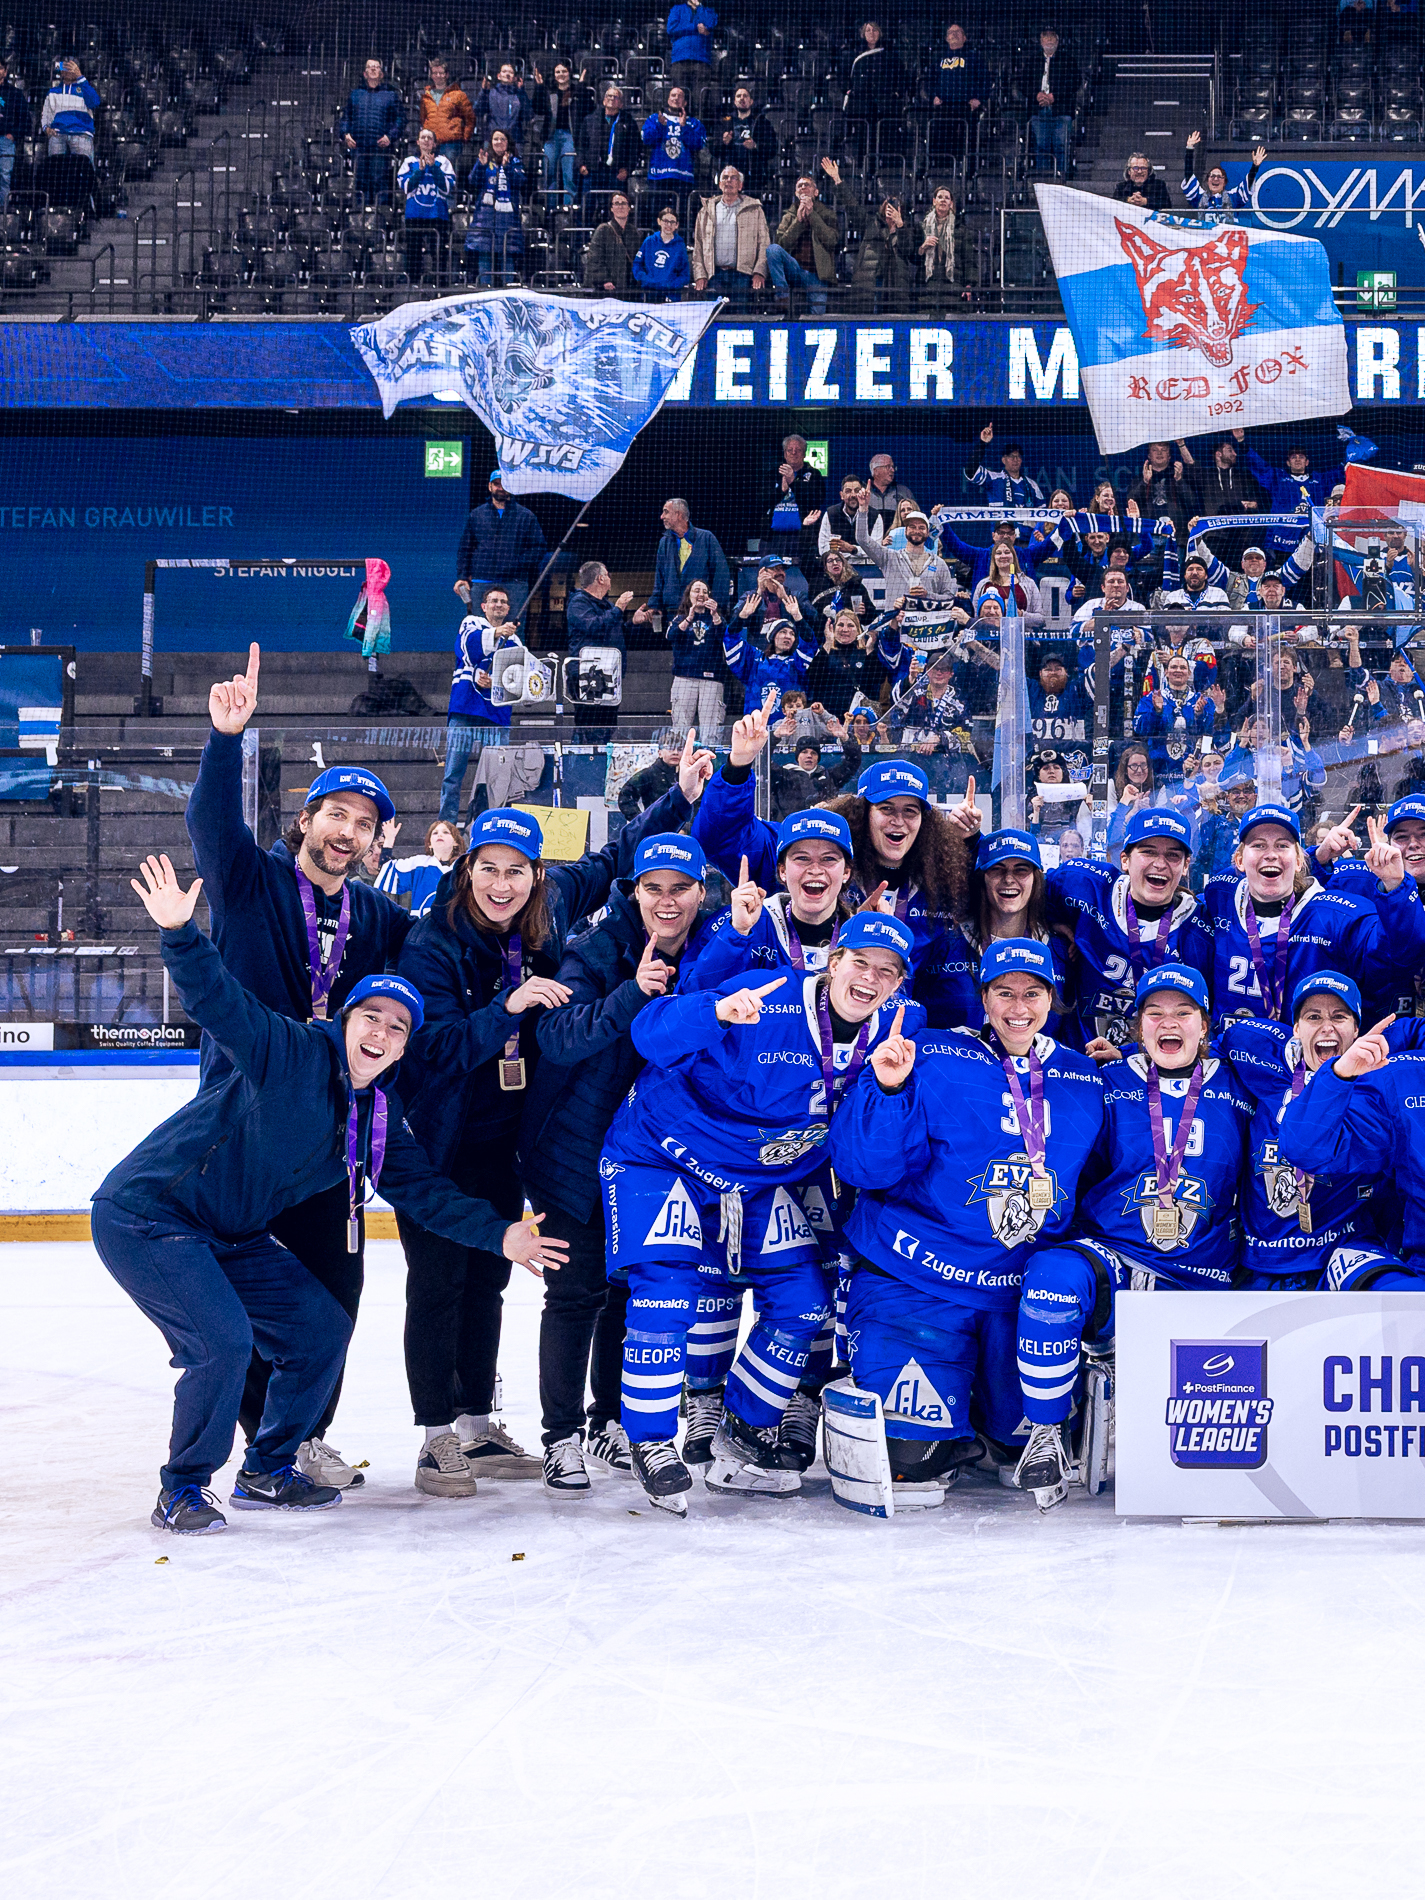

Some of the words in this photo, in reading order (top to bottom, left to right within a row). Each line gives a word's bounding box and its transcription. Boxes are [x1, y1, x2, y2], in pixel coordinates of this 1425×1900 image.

[1208, 399, 1244, 417] 1992
[84, 505, 234, 528] GRAUWILER
[1067, 859, 1113, 884] BOSSARD
[1064, 896, 1110, 931] GLENCORE
[90, 1024, 185, 1043] thermoplan
[1239, 1017, 1286, 1041] BOSSARD
[115, 1041, 135, 1049] Quality
[156, 1041, 185, 1049] Equipment
[757, 1051, 815, 1068] GLENCORE
[1062, 1070, 1092, 1085] Alfred
[684, 1156, 732, 1192] Zuger
[987, 1163, 1031, 1187] EV
[608, 1183, 620, 1255] mycasino
[655, 1199, 702, 1238] Sika
[769, 1204, 813, 1246] Sika
[921, 1250, 974, 1284] Zuger
[632, 1297, 690, 1310] McDonald's
[1017, 1336, 1078, 1357] KELEOPS
[1195, 1382, 1256, 1393] PostFinance
[894, 1379, 944, 1421] Sika
[1166, 1398, 1272, 1425] WOMEN'S
[1175, 1426, 1259, 1453] LEAGUE
